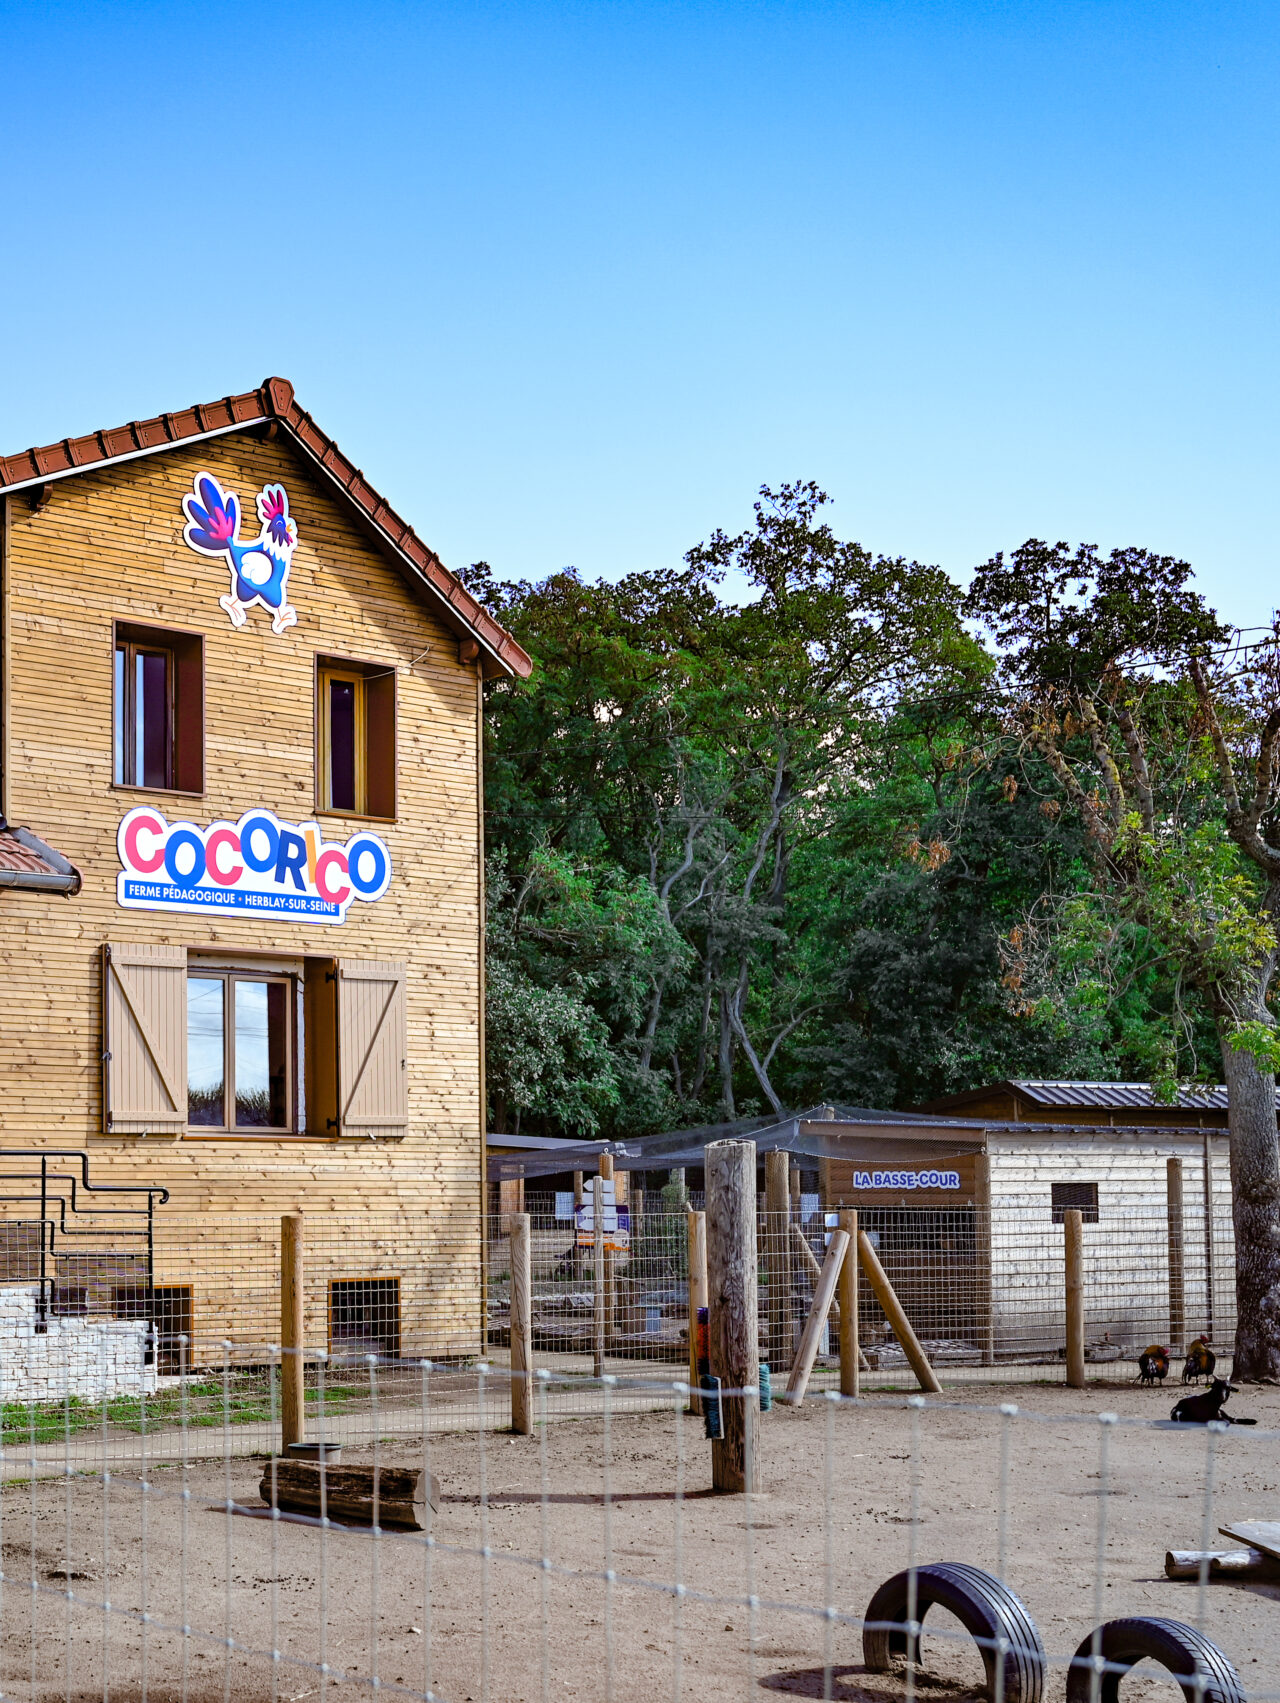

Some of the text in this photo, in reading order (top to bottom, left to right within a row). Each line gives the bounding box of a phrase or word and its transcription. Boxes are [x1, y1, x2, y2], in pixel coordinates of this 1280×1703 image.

[124, 815, 387, 905] COCORICO
[129, 883, 337, 914] FERME PÉDAGOGIQUE HERBLAY-SUR-SEINE
[854, 1172, 958, 1187] LA BASSE-COUR
